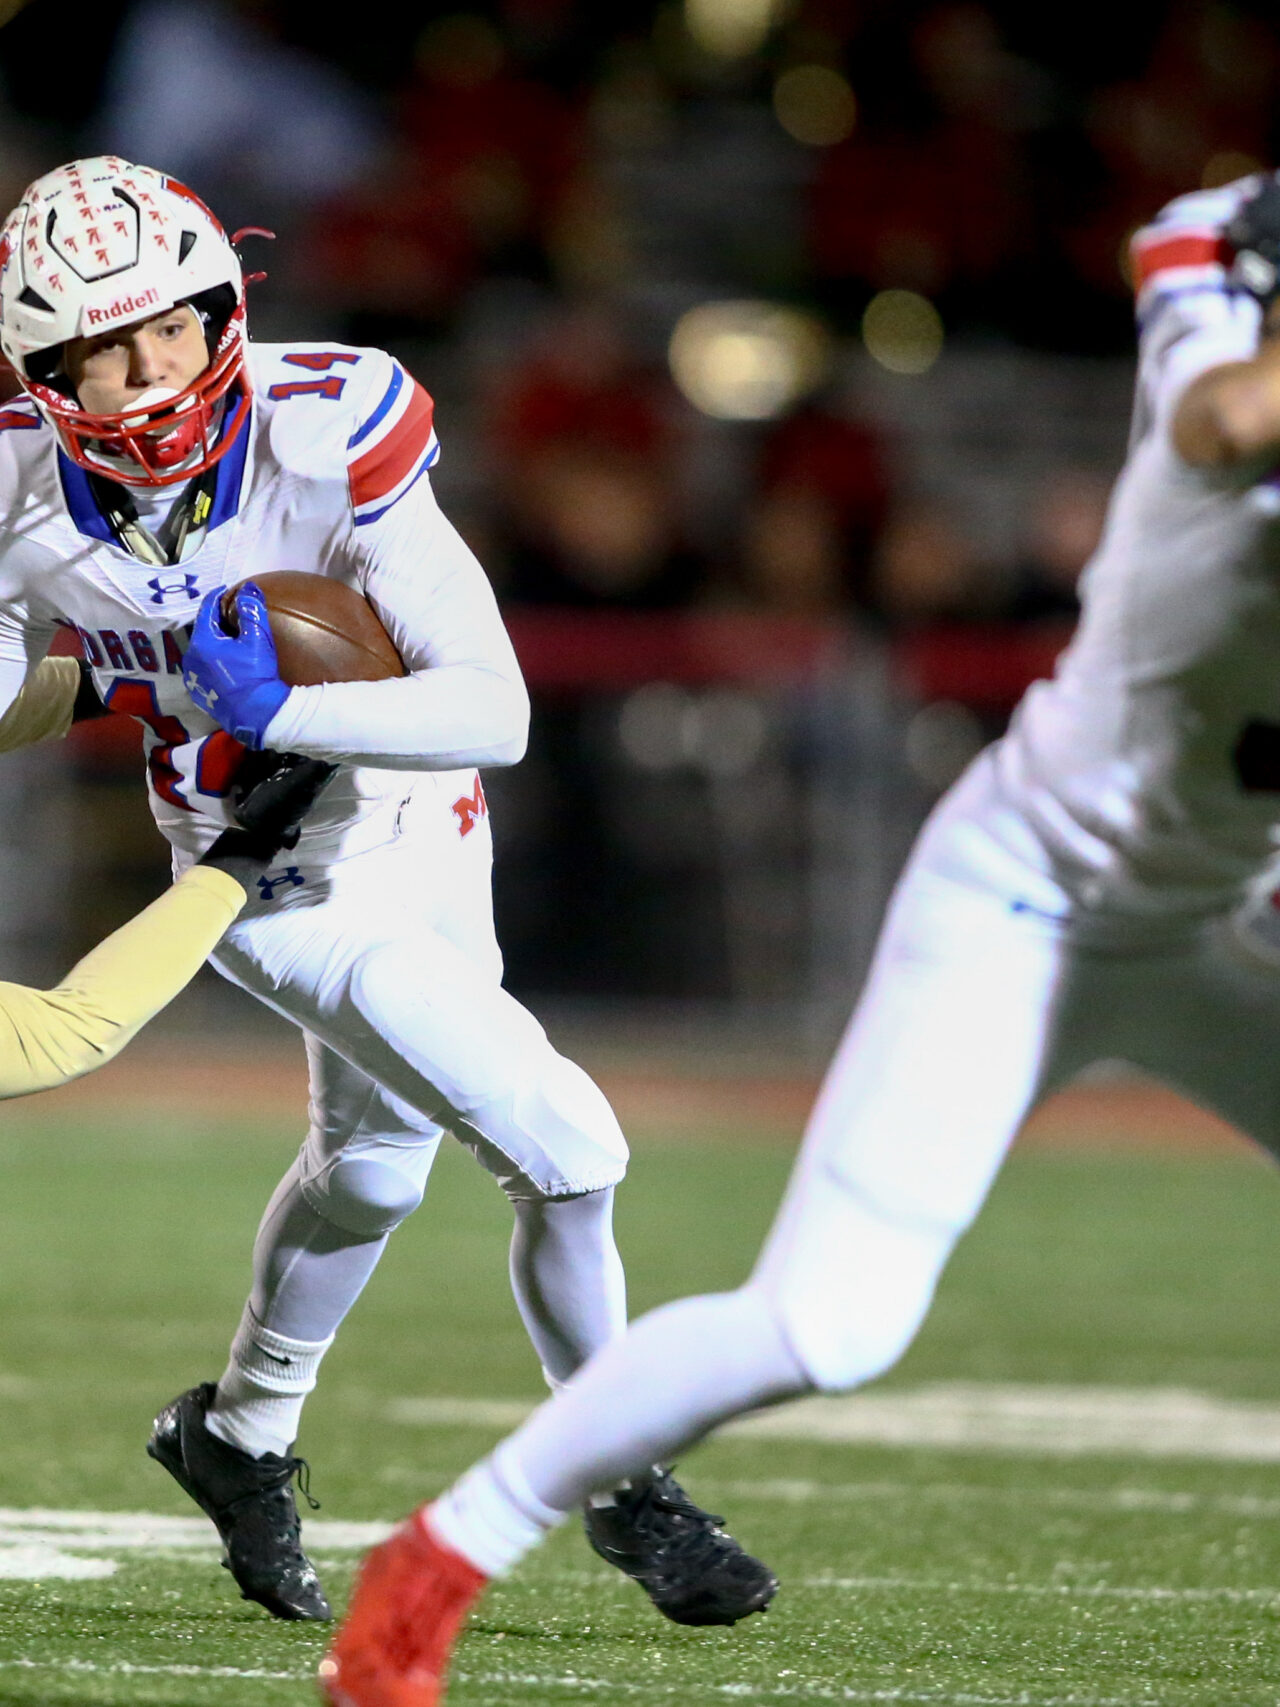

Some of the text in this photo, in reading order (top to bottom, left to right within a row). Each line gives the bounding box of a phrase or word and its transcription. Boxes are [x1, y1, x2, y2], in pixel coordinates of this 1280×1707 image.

[87, 288, 160, 326] Riddell
[267, 351, 363, 402] 14
[65, 622, 195, 675] ORGA
